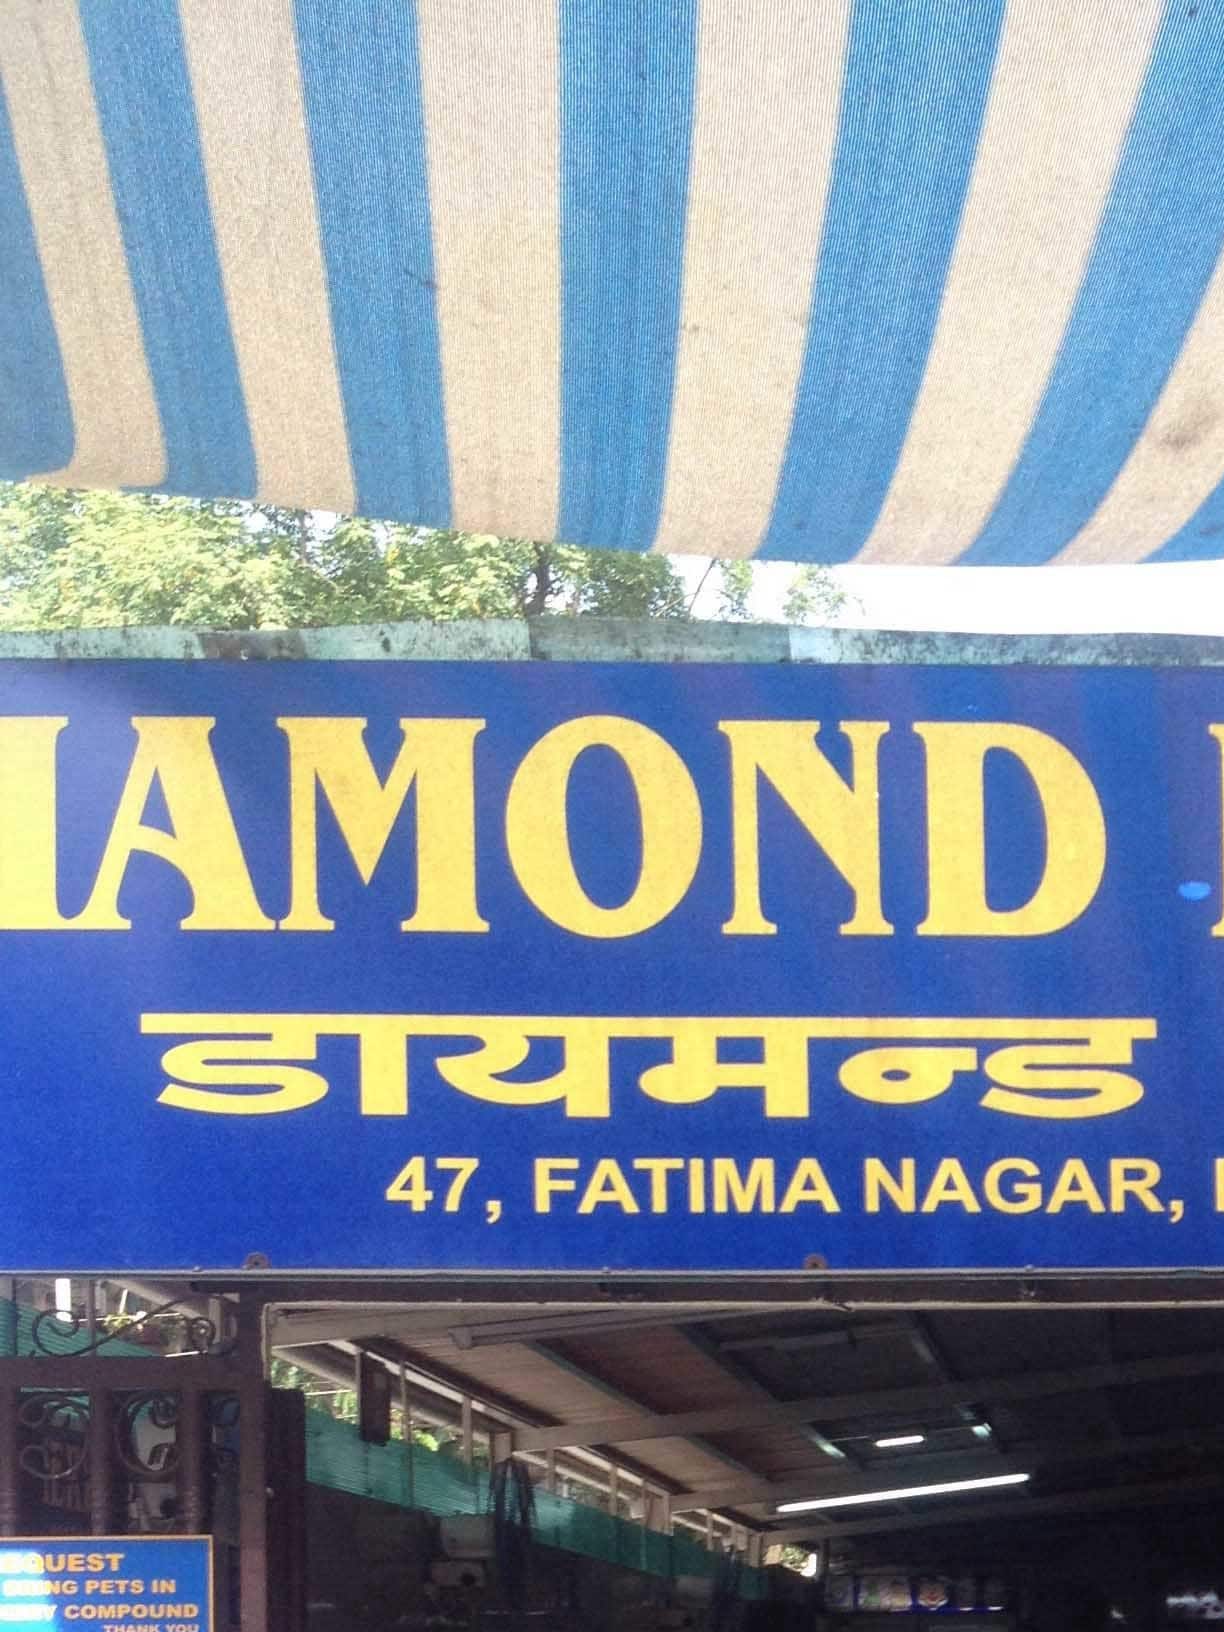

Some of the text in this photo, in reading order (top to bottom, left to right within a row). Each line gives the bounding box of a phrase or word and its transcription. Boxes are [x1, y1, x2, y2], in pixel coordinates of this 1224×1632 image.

[139, 1012, 1156, 1118] डायमन्ड
[385, 1157, 503, 1222] 47,
[534, 1158, 838, 1214] FATIMA
[864, 1157, 1185, 1223] NAGAR,
[85, 1580, 144, 1595] PETS
[152, 1580, 177, 1593] IN
[64, 1604, 199, 1620] COMPOUND
